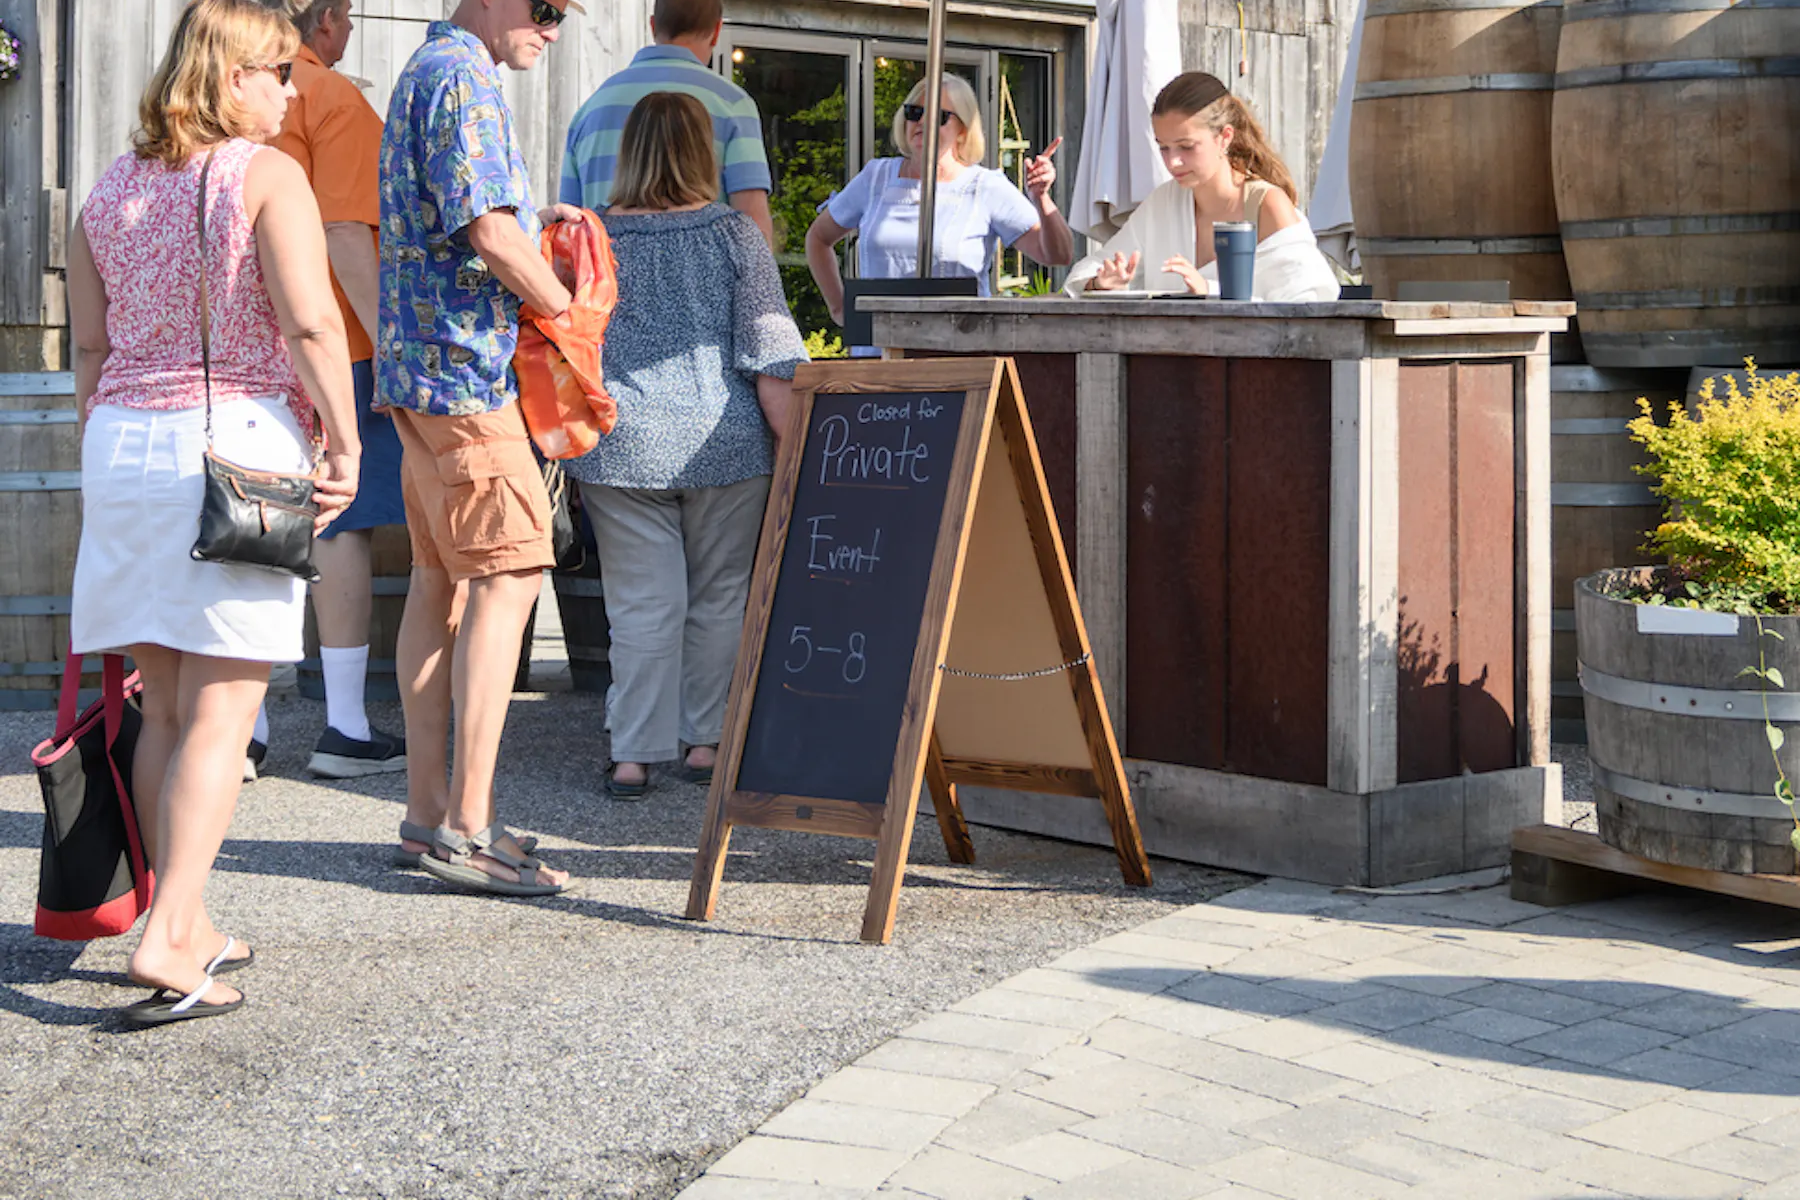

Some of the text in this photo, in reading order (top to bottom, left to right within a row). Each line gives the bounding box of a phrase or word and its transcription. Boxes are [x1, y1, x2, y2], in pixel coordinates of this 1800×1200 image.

[857, 397, 944, 423] Closed for
[818, 414, 930, 485] Private
[807, 514, 882, 573] Event
